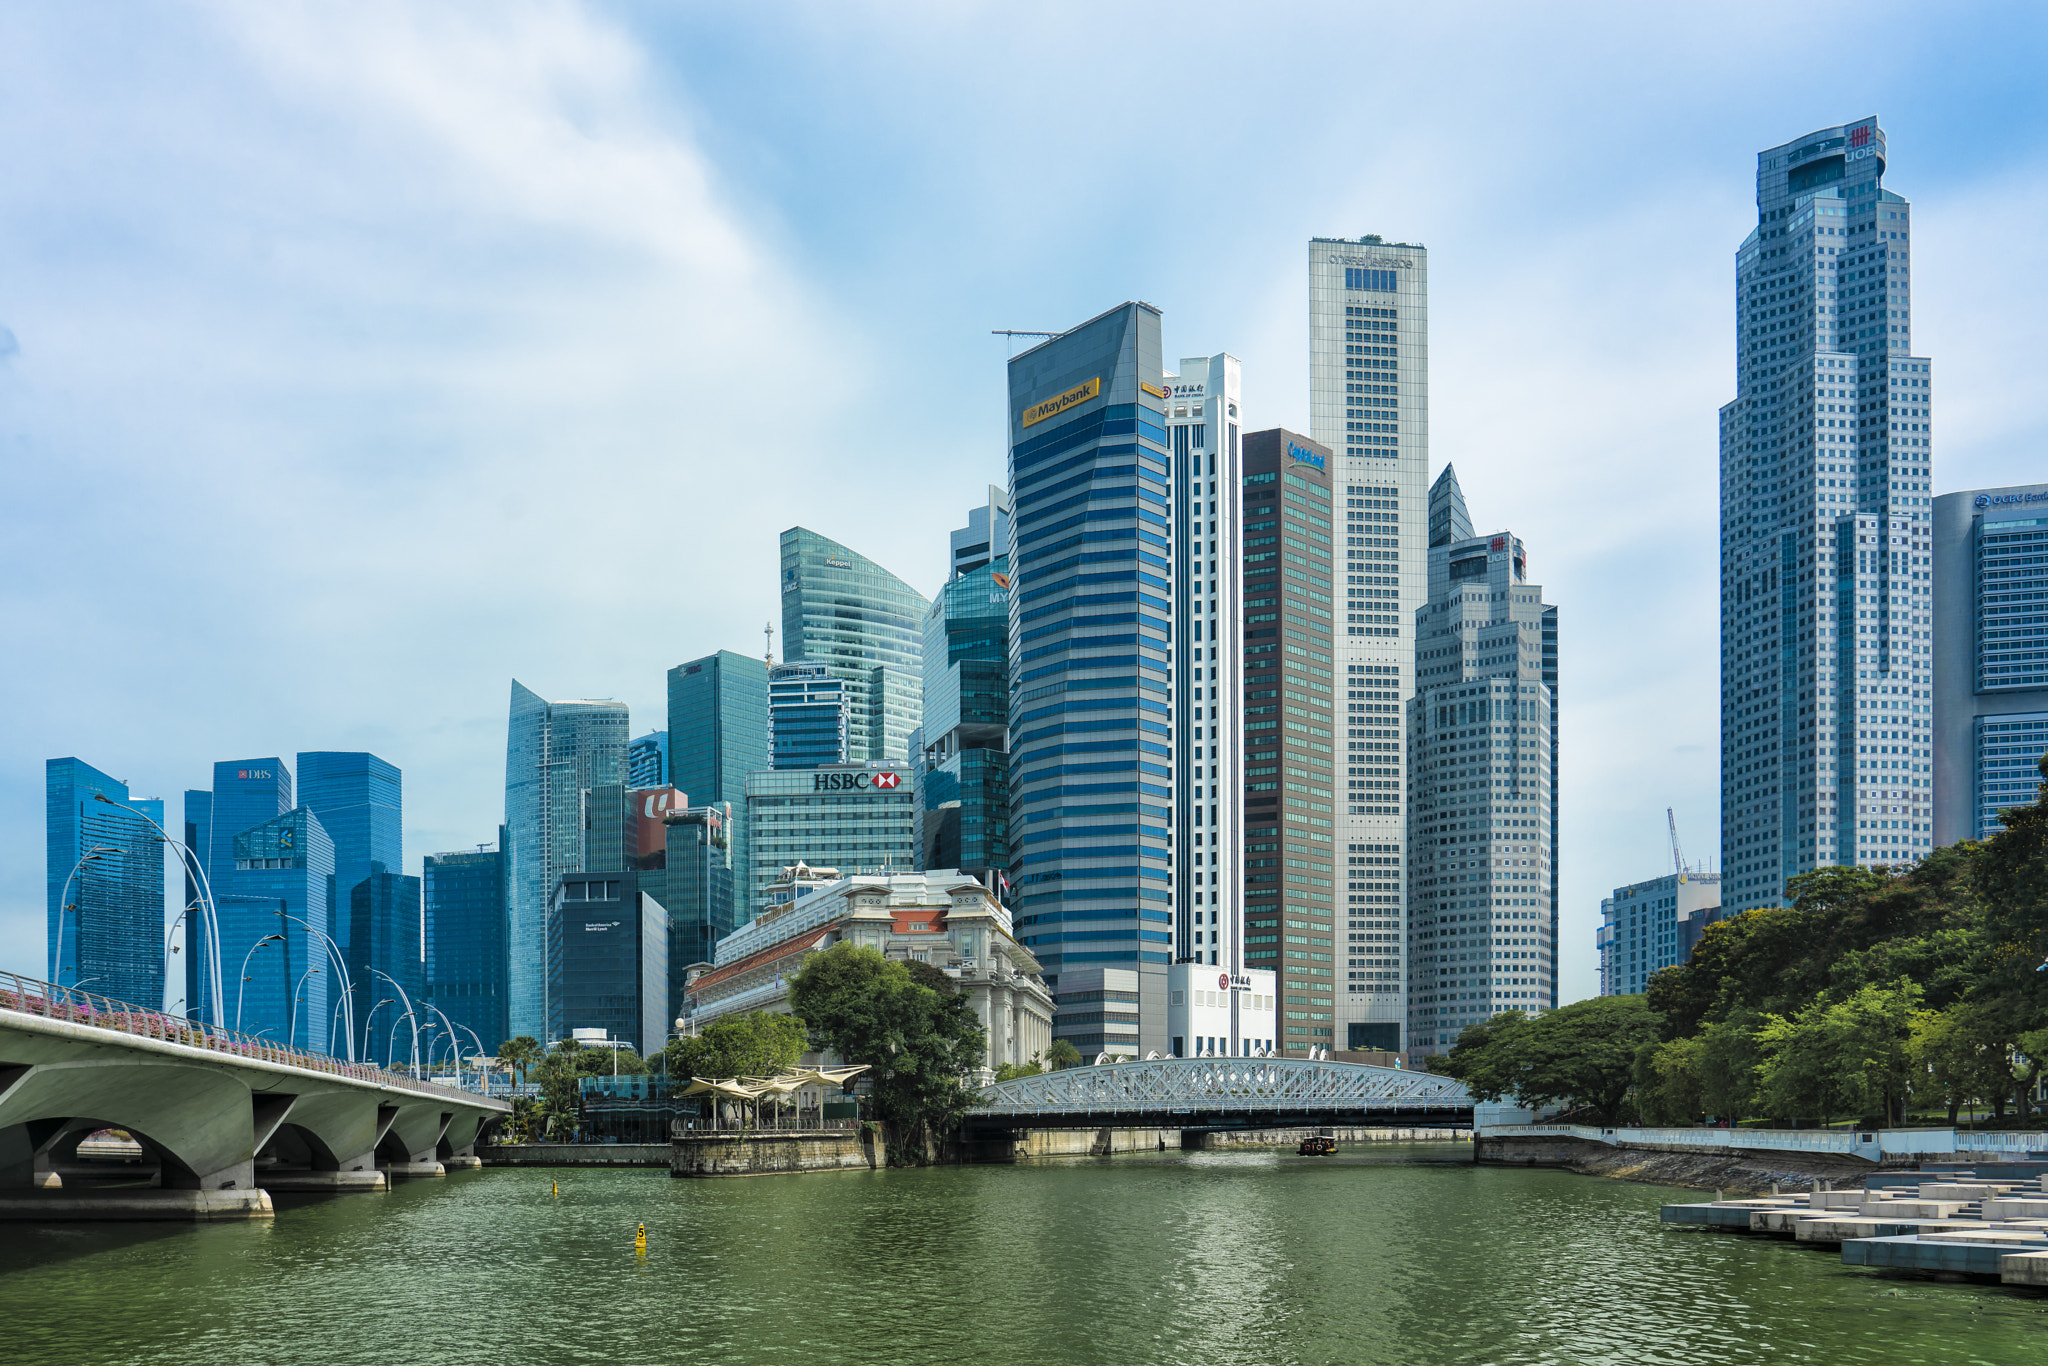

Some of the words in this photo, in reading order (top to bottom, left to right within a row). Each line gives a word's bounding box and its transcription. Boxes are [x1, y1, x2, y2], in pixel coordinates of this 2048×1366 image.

[1845, 145, 1876, 162] UOB
[1174, 384, 1204, 393] 中国银行
[1038, 385, 1090, 417] Maybank
[1288, 441, 1325, 469] CapitaLand
[1992, 494, 2023, 504] OCBC
[826, 558, 851, 567] Keppel
[1487, 551, 1509, 564] UOB
[249, 769, 271, 779] DBS
[814, 772, 869, 790] HSBC
[638, 1228, 645, 1237] 5
